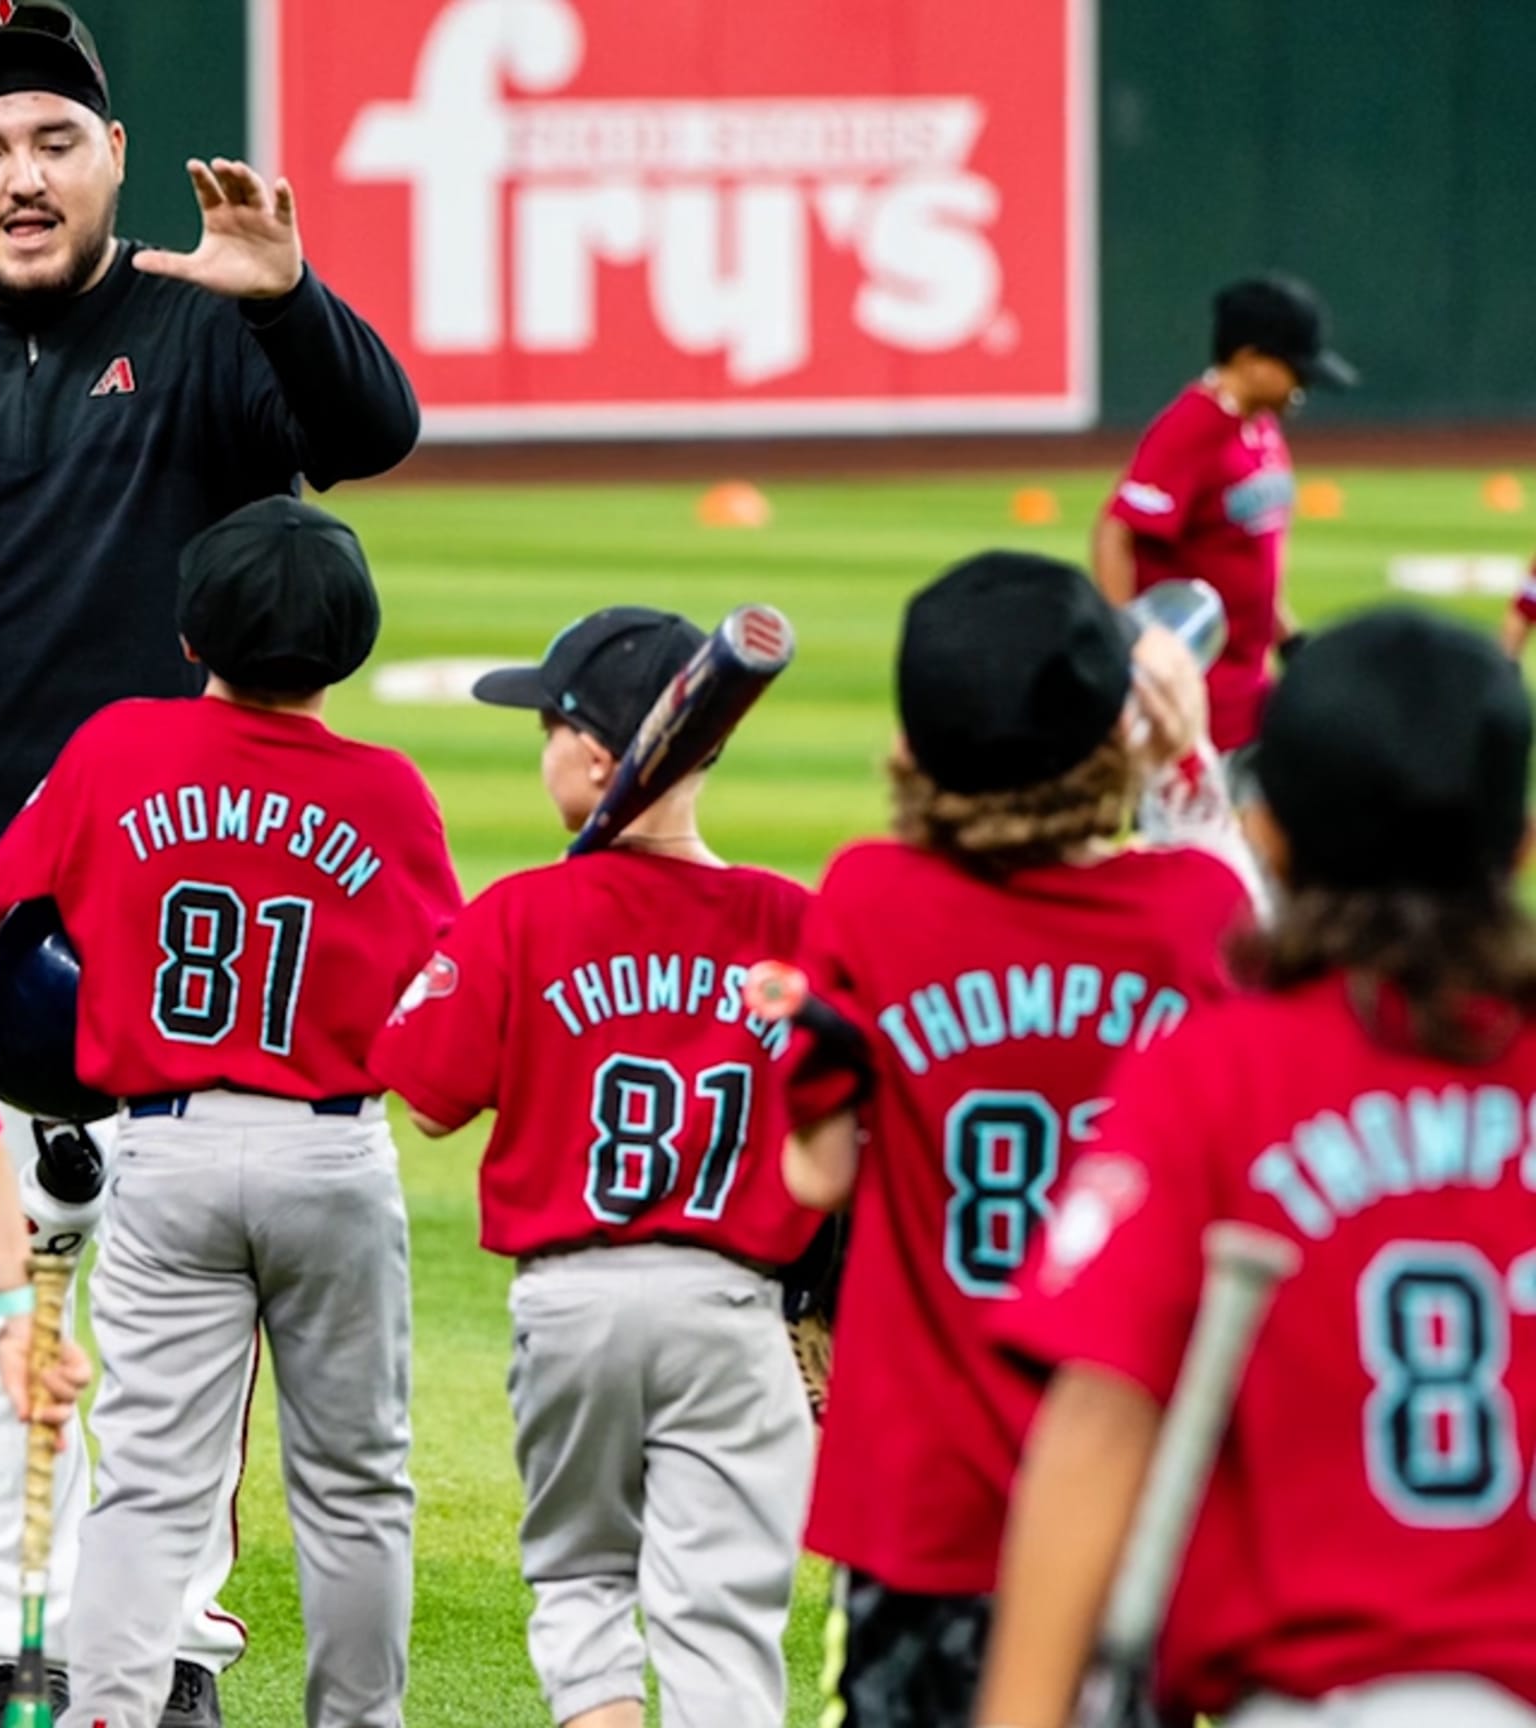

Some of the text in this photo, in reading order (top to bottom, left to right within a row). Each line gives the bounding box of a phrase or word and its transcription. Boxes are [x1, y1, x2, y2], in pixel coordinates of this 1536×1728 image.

[335, 0, 1001, 387] fry's
[118, 785, 382, 897] THOMPSON
[151, 880, 313, 1057] 81
[878, 963, 1189, 1075] THOMPSO
[583, 1052, 753, 1224] 81
[943, 1088, 1117, 1300] 8
[1248, 1082, 1536, 1241] THOMP
[1355, 1238, 1536, 1531] 8
